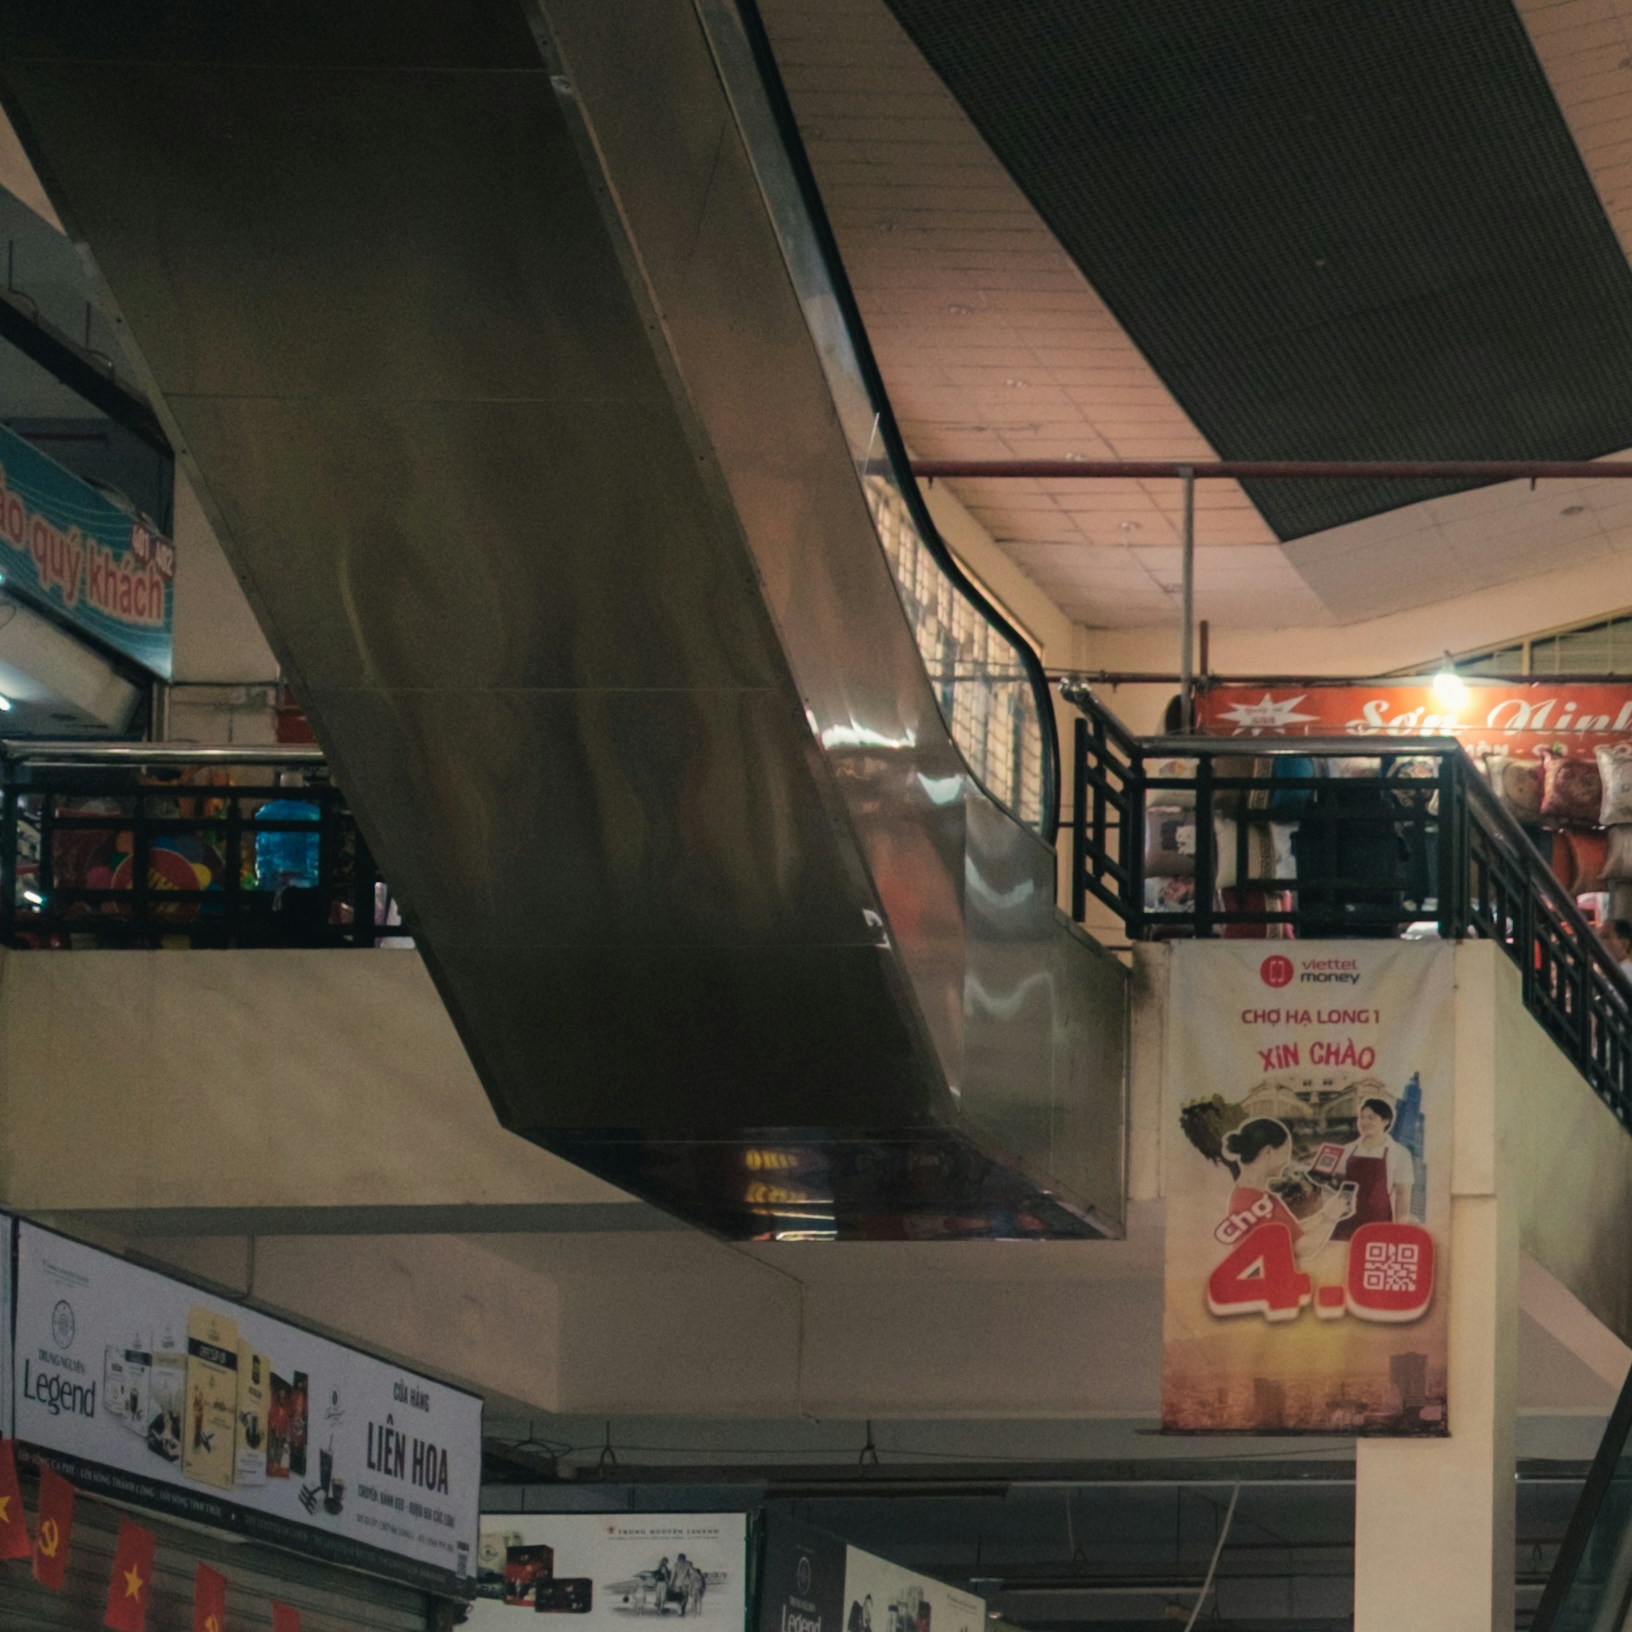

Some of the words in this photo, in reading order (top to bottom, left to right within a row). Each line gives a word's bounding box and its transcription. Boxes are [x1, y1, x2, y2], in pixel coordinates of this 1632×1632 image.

[86, 539, 163, 625] khách
[1301, 971, 1361, 986] money
[1302, 957, 1358, 971] viettel
[1241, 1008, 1281, 1026] CHỢ
[1285, 1009, 1313, 1028] HẠ
[1317, 1009, 1370, 1025] LONG
[1309, 1037, 1376, 1071] CHÀO
[24, 1358, 96, 1418] Legend
[367, 1413, 407, 1480] LIÊN
[411, 1438, 449, 1496] HOA
